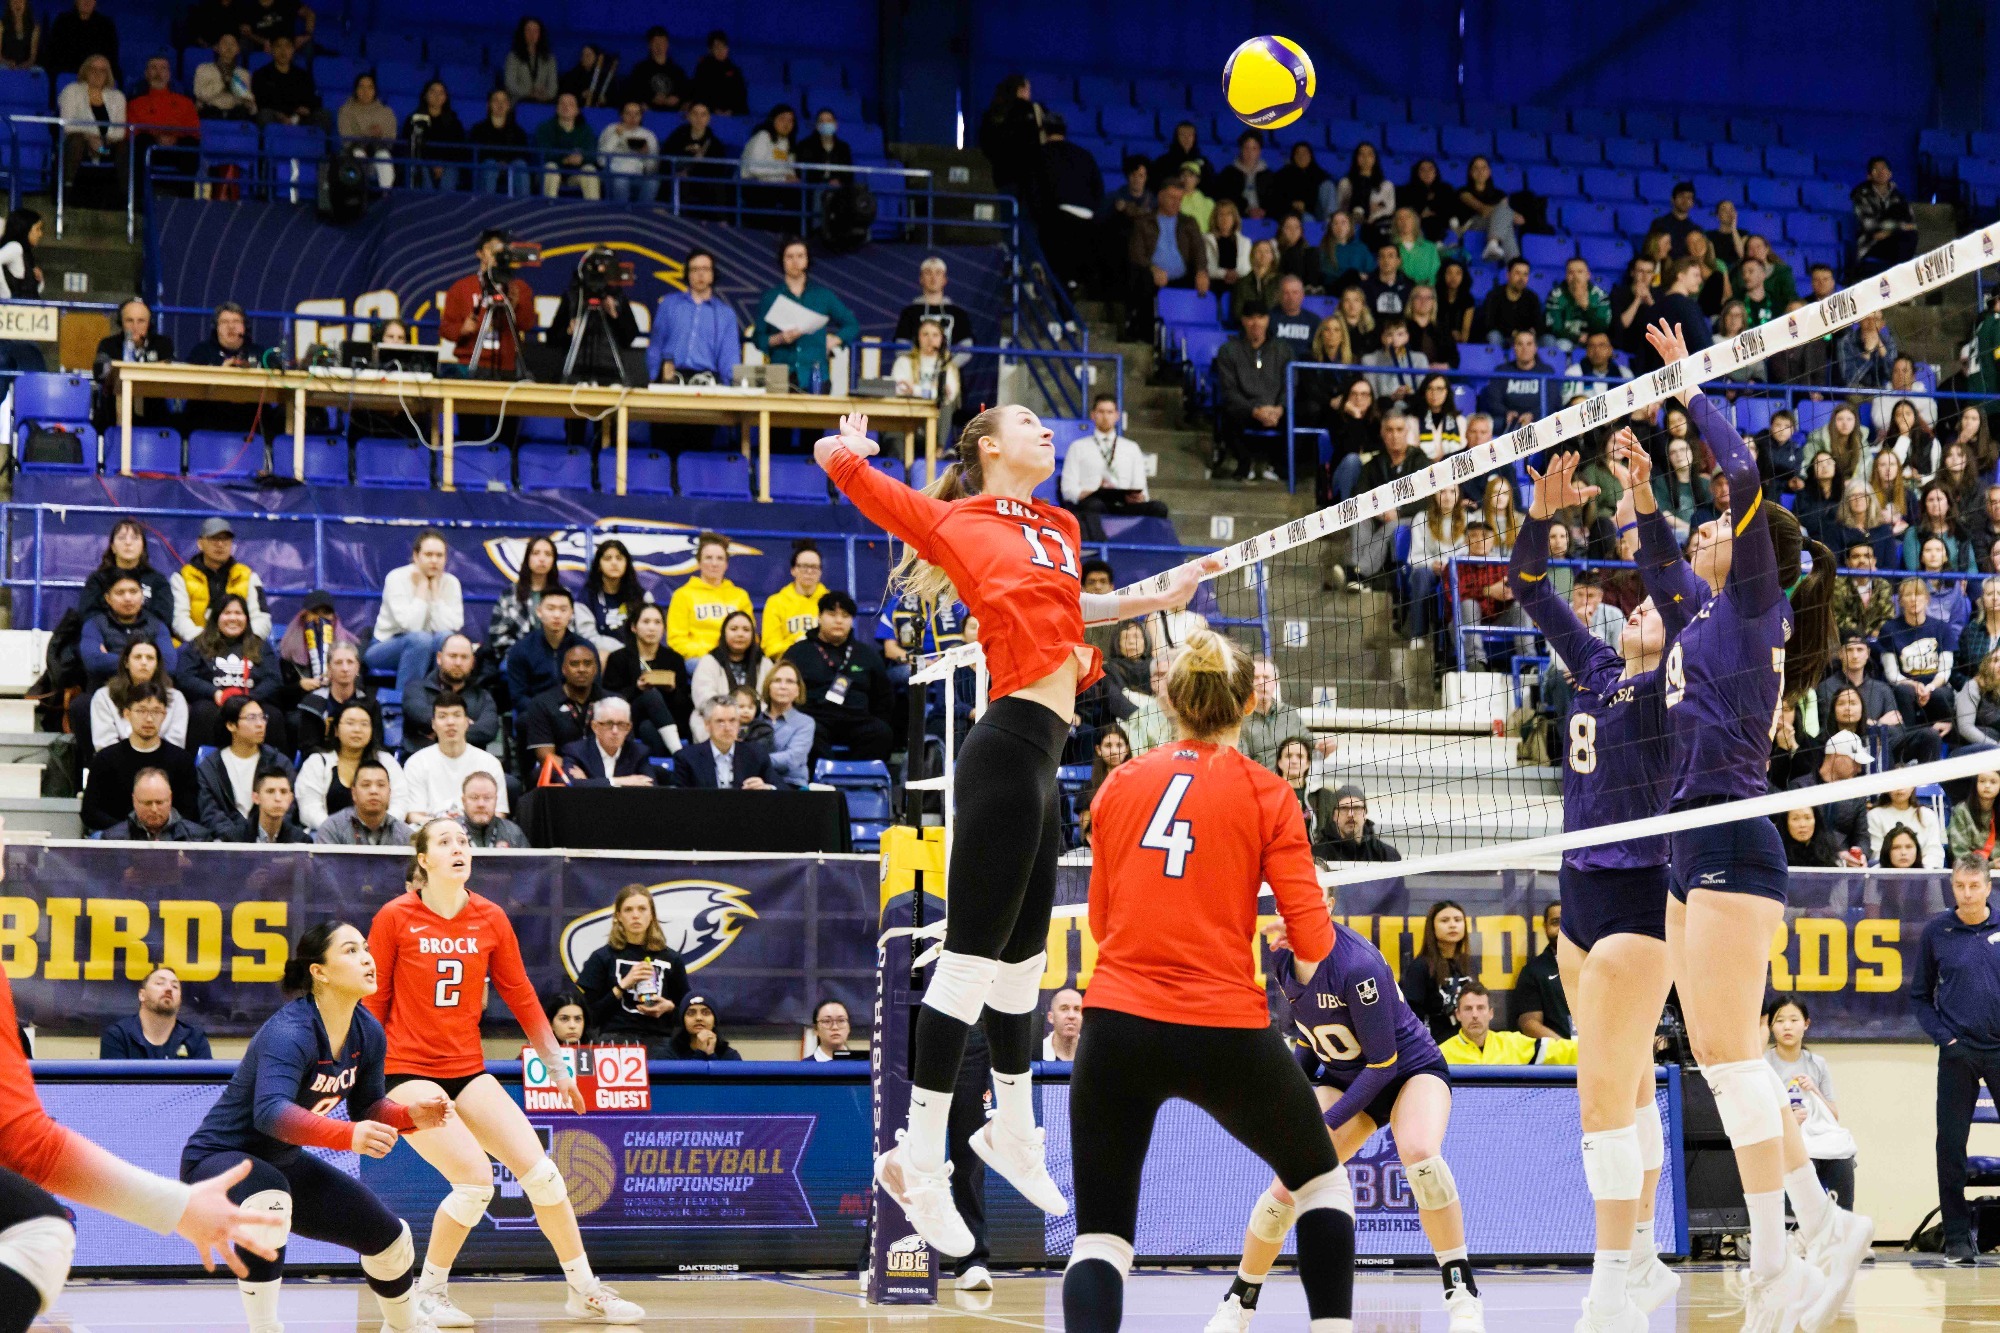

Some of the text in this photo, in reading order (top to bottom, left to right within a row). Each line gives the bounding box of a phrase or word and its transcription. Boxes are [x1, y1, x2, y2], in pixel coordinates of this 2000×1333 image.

[788, 617, 818, 633] UB
[1569, 713, 1597, 775] 8
[1139, 773, 1195, 879] 4
[0, 896, 289, 983] BIRDS
[419, 937, 479, 953] BROCK
[435, 959, 464, 1007] 2
[599, 1056, 643, 1083] 02
[524, 1089, 649, 1110] HOM GUEST
[623, 1131, 744, 1147] CHAMPIONNAT
[624, 1149, 784, 1174] VOLLEYBALL
[623, 1177, 754, 1192] CHAMPIONSHIP
[886, 1251, 929, 1271] UBC
